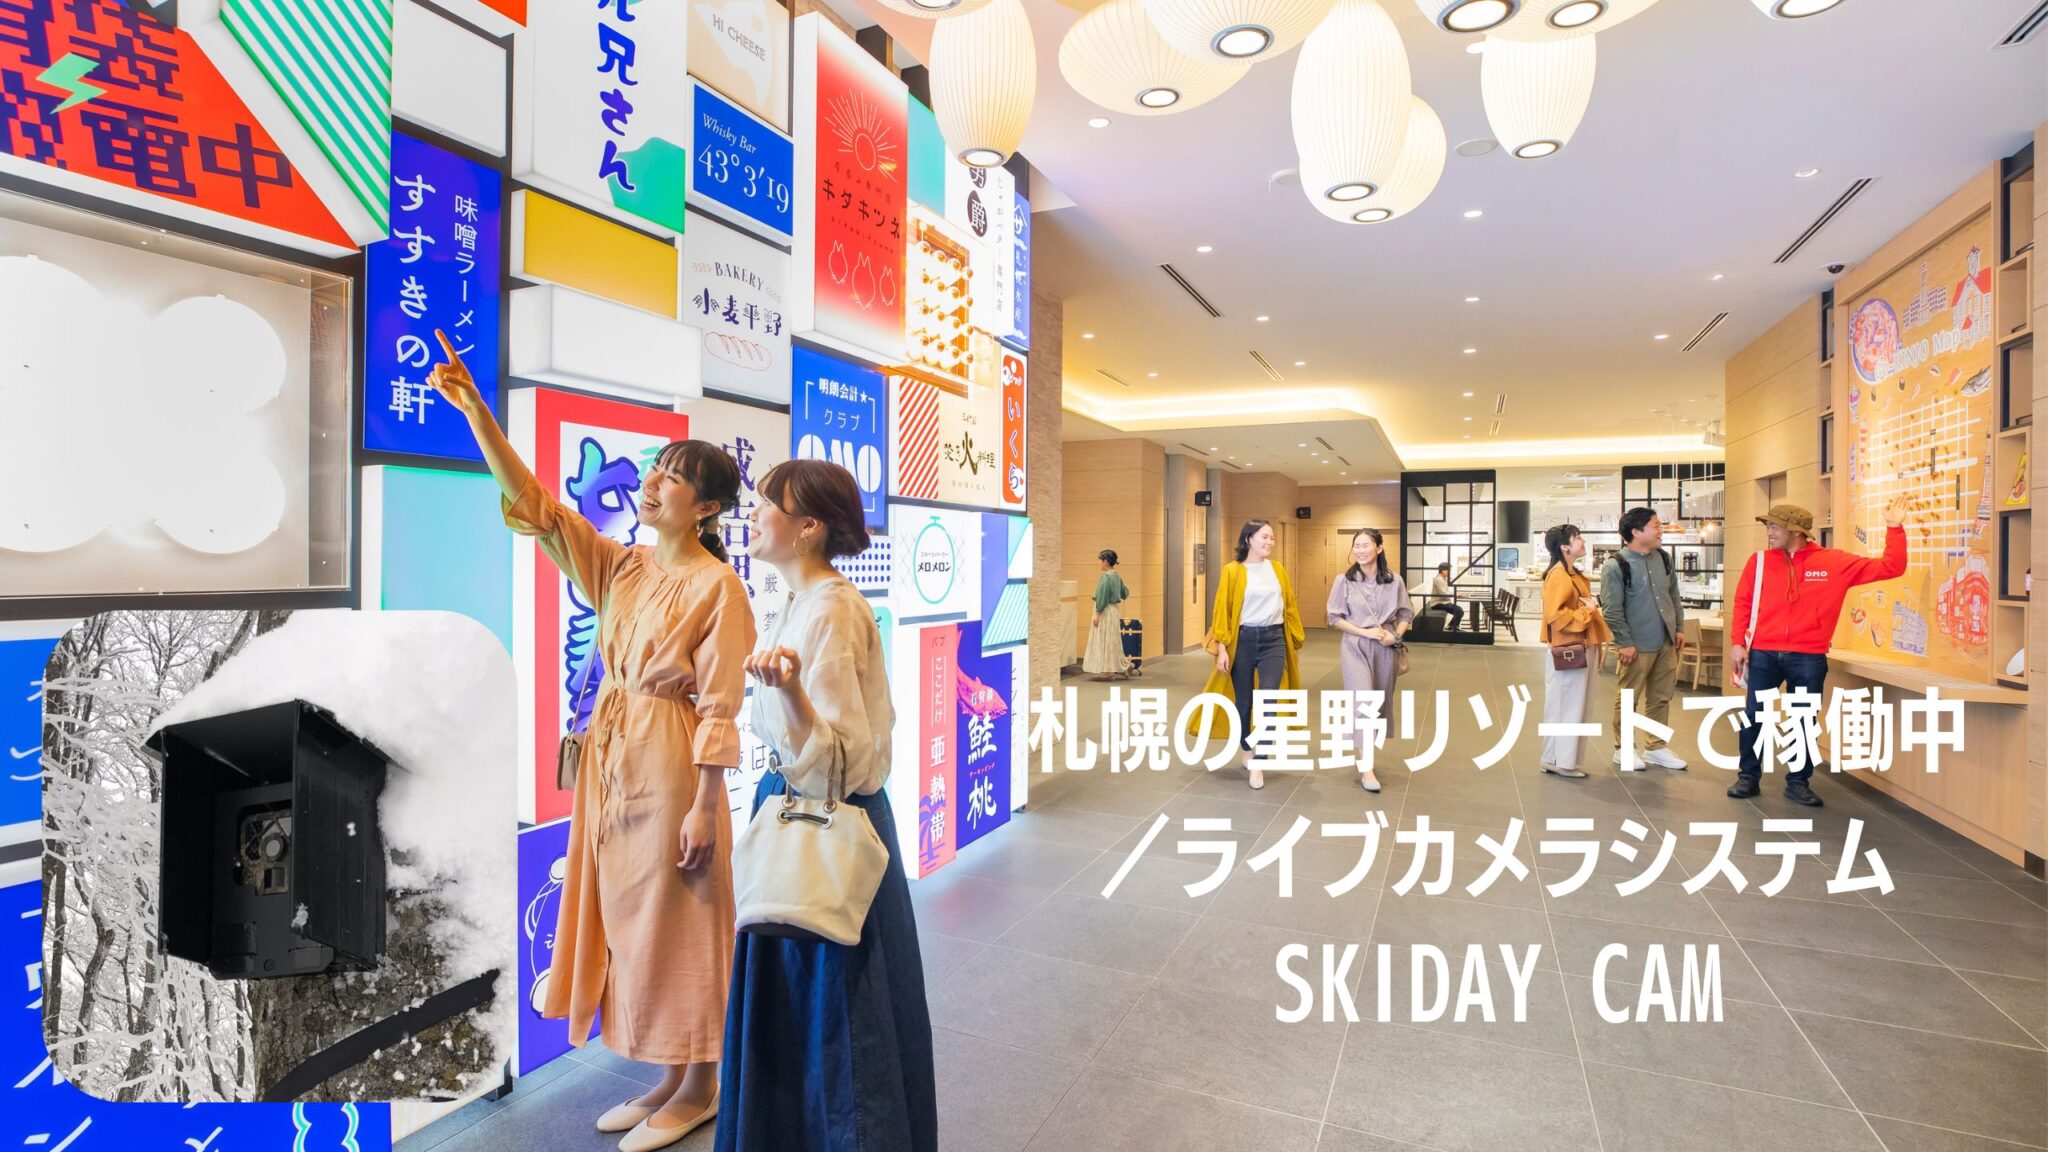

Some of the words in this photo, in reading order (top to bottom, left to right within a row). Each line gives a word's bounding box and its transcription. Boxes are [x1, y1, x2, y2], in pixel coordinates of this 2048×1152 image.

[712, 14, 724, 33] HI
[728, 26, 766, 61] CHEESE
[702, 113, 738, 146] Whisky
[739, 135, 757, 154] Bar
[822, 178, 900, 239] キタキツネ
[388, 174, 437, 425] すすきの軒
[454, 194, 479, 357] 味噌ラーメン
[714, 261, 764, 291] BAKERY
[692, 287, 782, 337] 小麦平野
[1933, 329, 1960, 356] Map
[818, 377, 858, 403] 明朗会計
[824, 407, 860, 431] クラブ
[1006, 397, 1023, 490] いくら
[917, 562, 951, 572] メロメロン
[967, 712, 997, 764] 鮭
[930, 735, 946, 843] 亜熱帯
[966, 775, 997, 830] 桃
